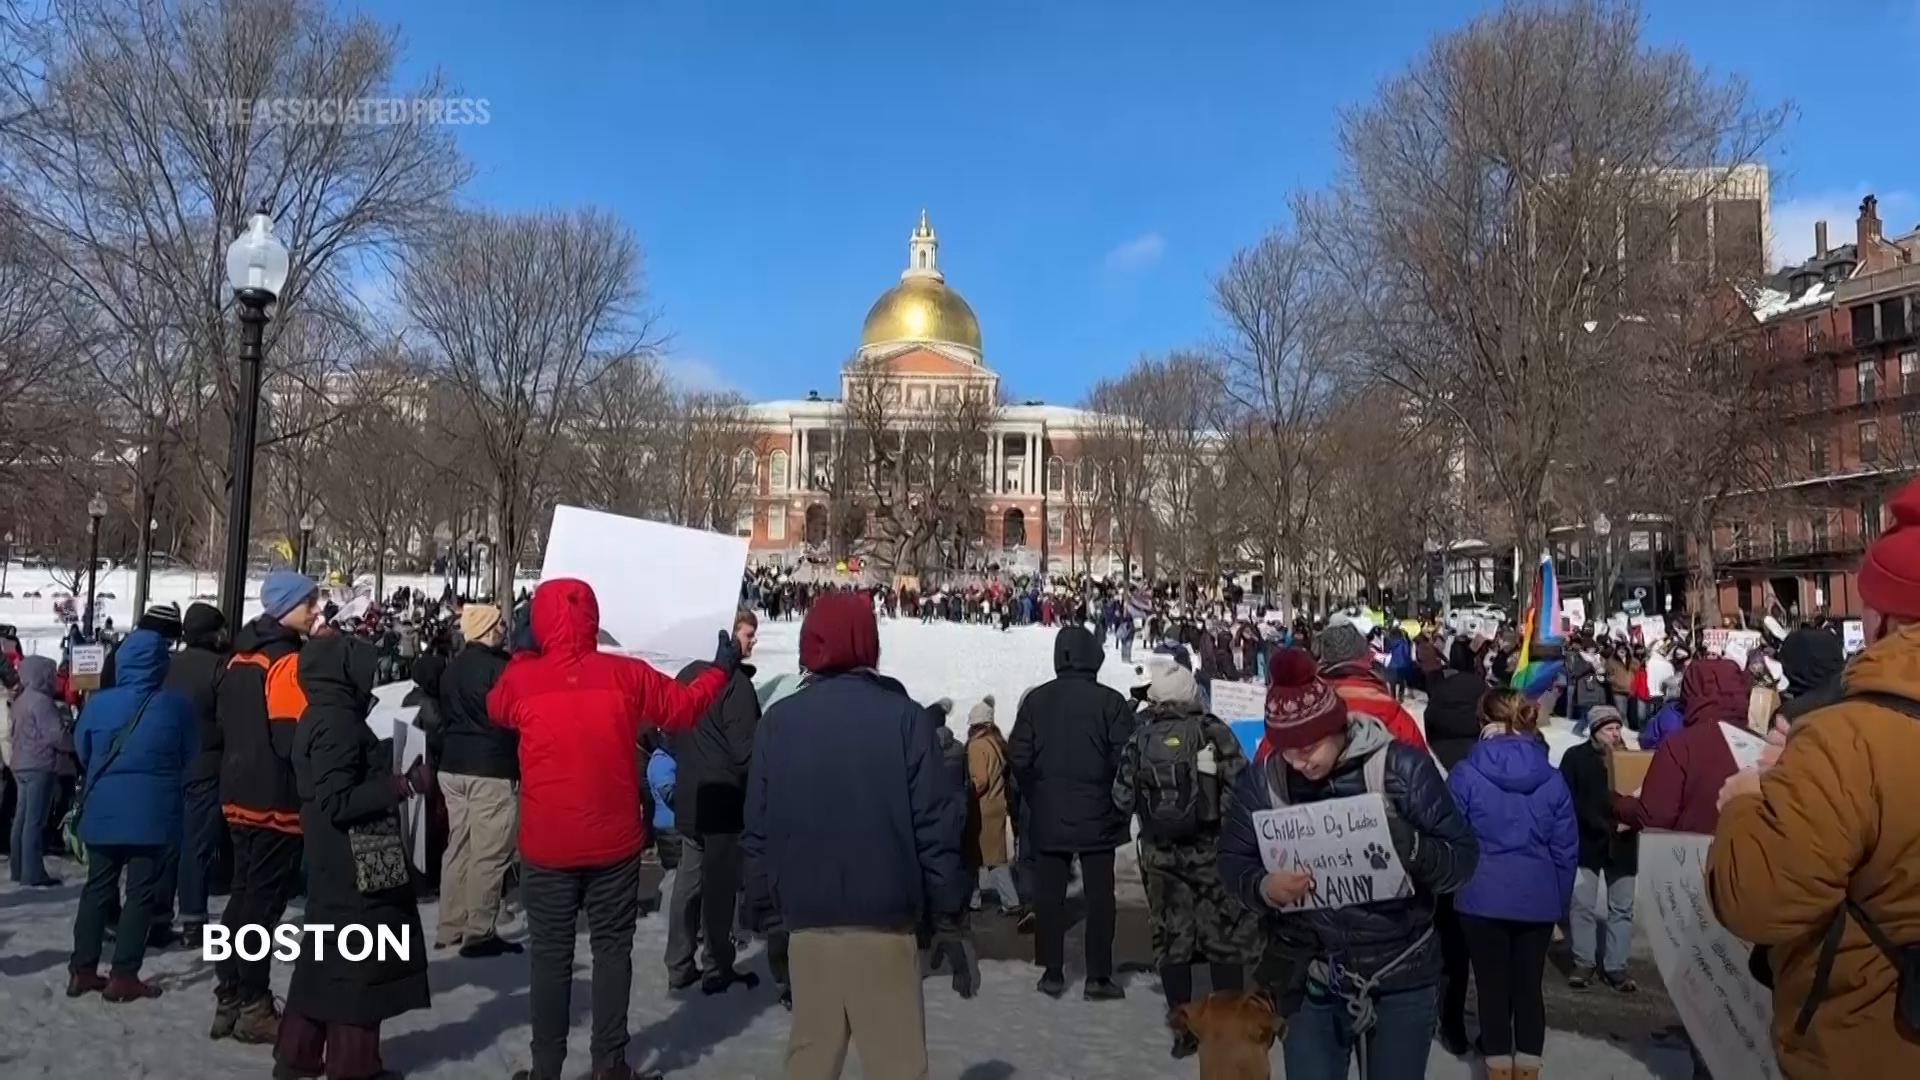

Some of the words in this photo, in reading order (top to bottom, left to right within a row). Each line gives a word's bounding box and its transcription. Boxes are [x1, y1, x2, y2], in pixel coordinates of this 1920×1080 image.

[1262, 818, 1315, 840] Childless
[1294, 848, 1353, 877] Against
[1293, 874, 1373, 908] RANNY
